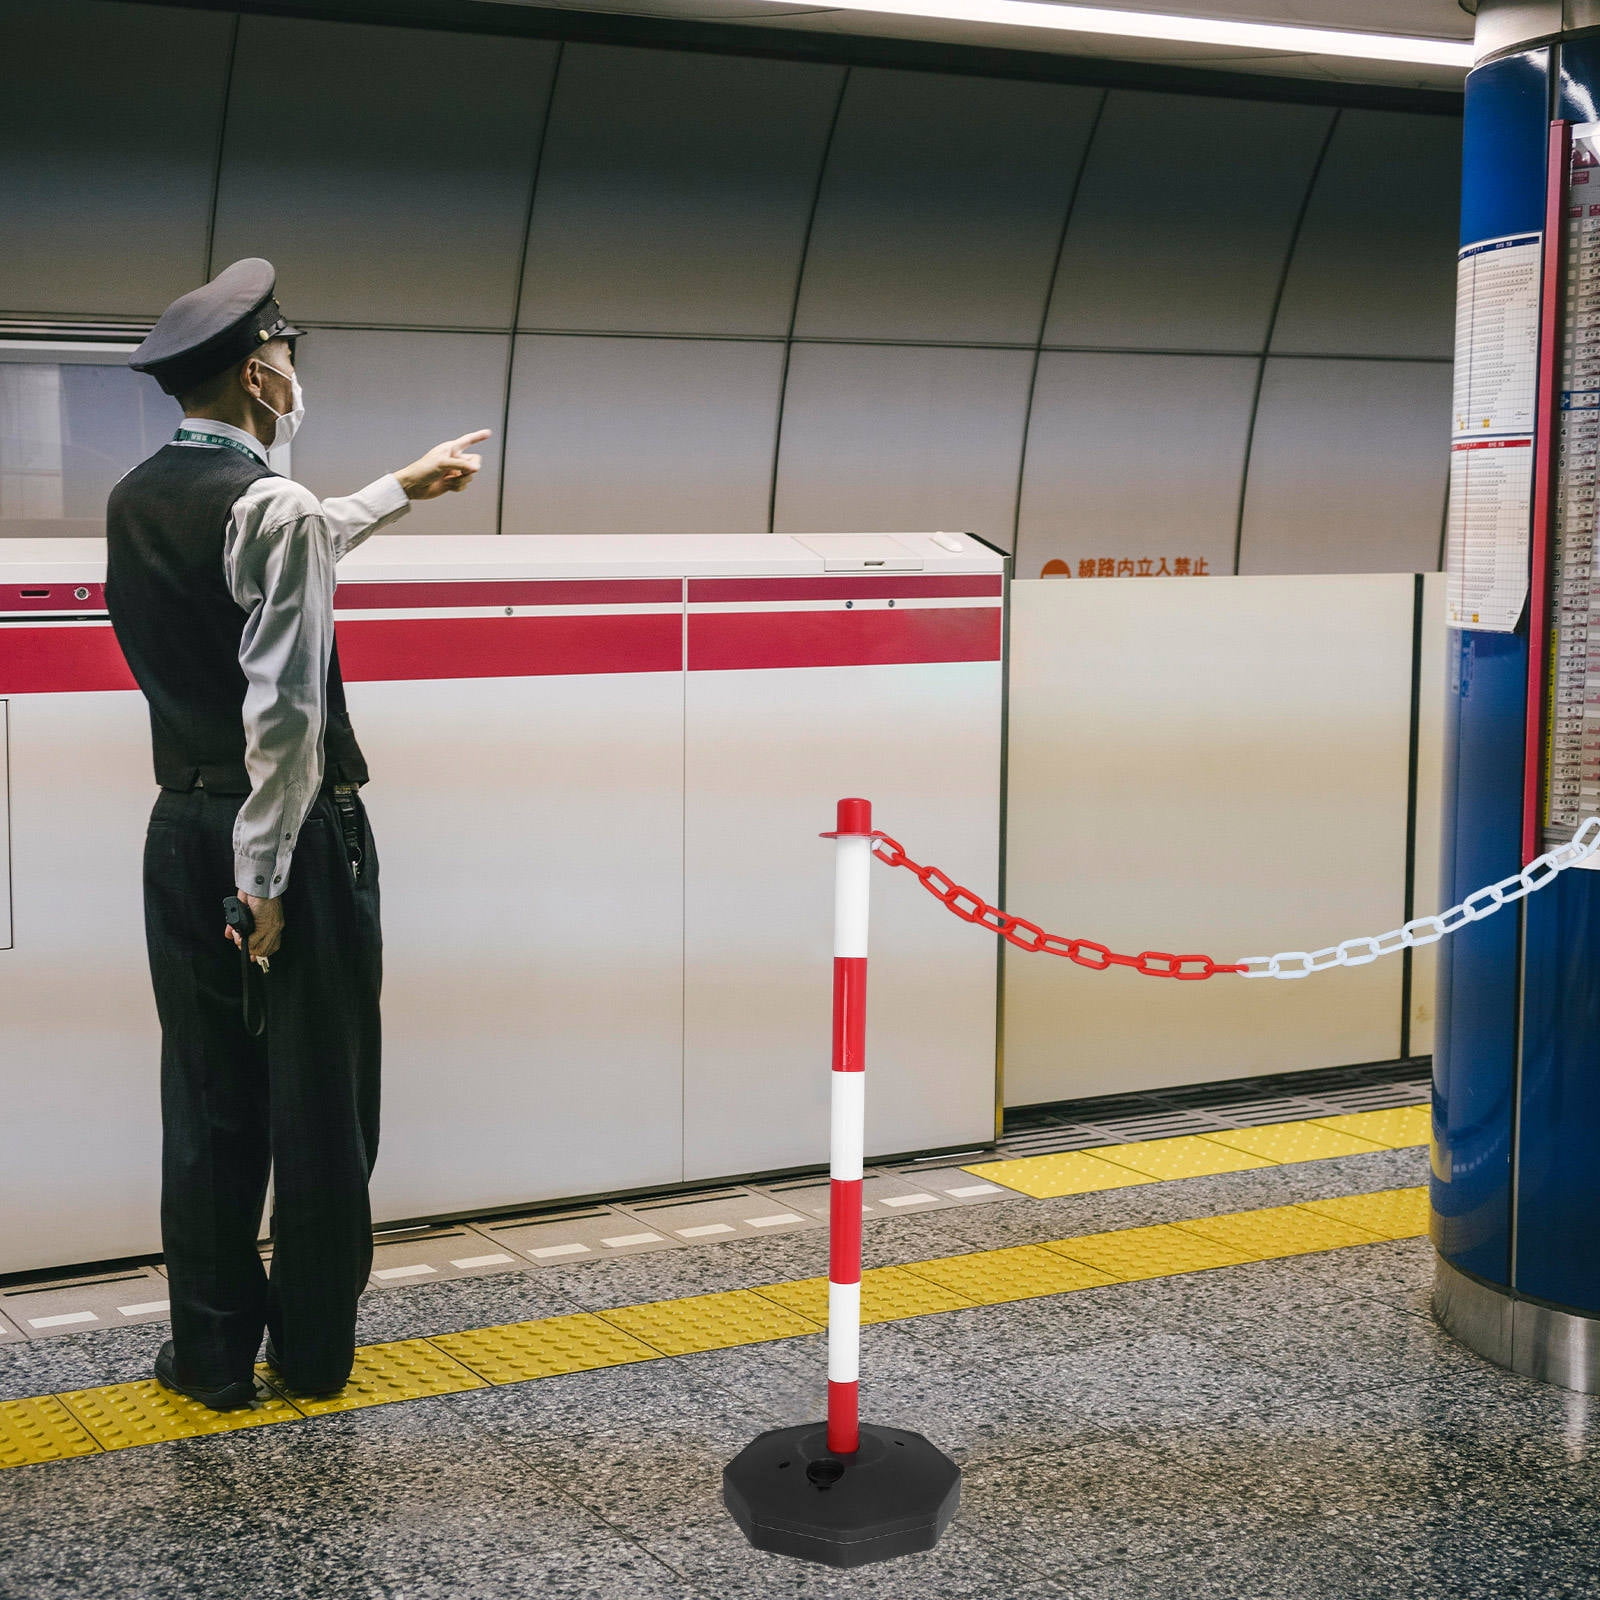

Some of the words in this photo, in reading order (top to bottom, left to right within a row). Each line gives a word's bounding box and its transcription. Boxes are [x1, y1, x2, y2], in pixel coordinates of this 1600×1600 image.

[1078, 556, 1210, 578] 線路内立入禁止
